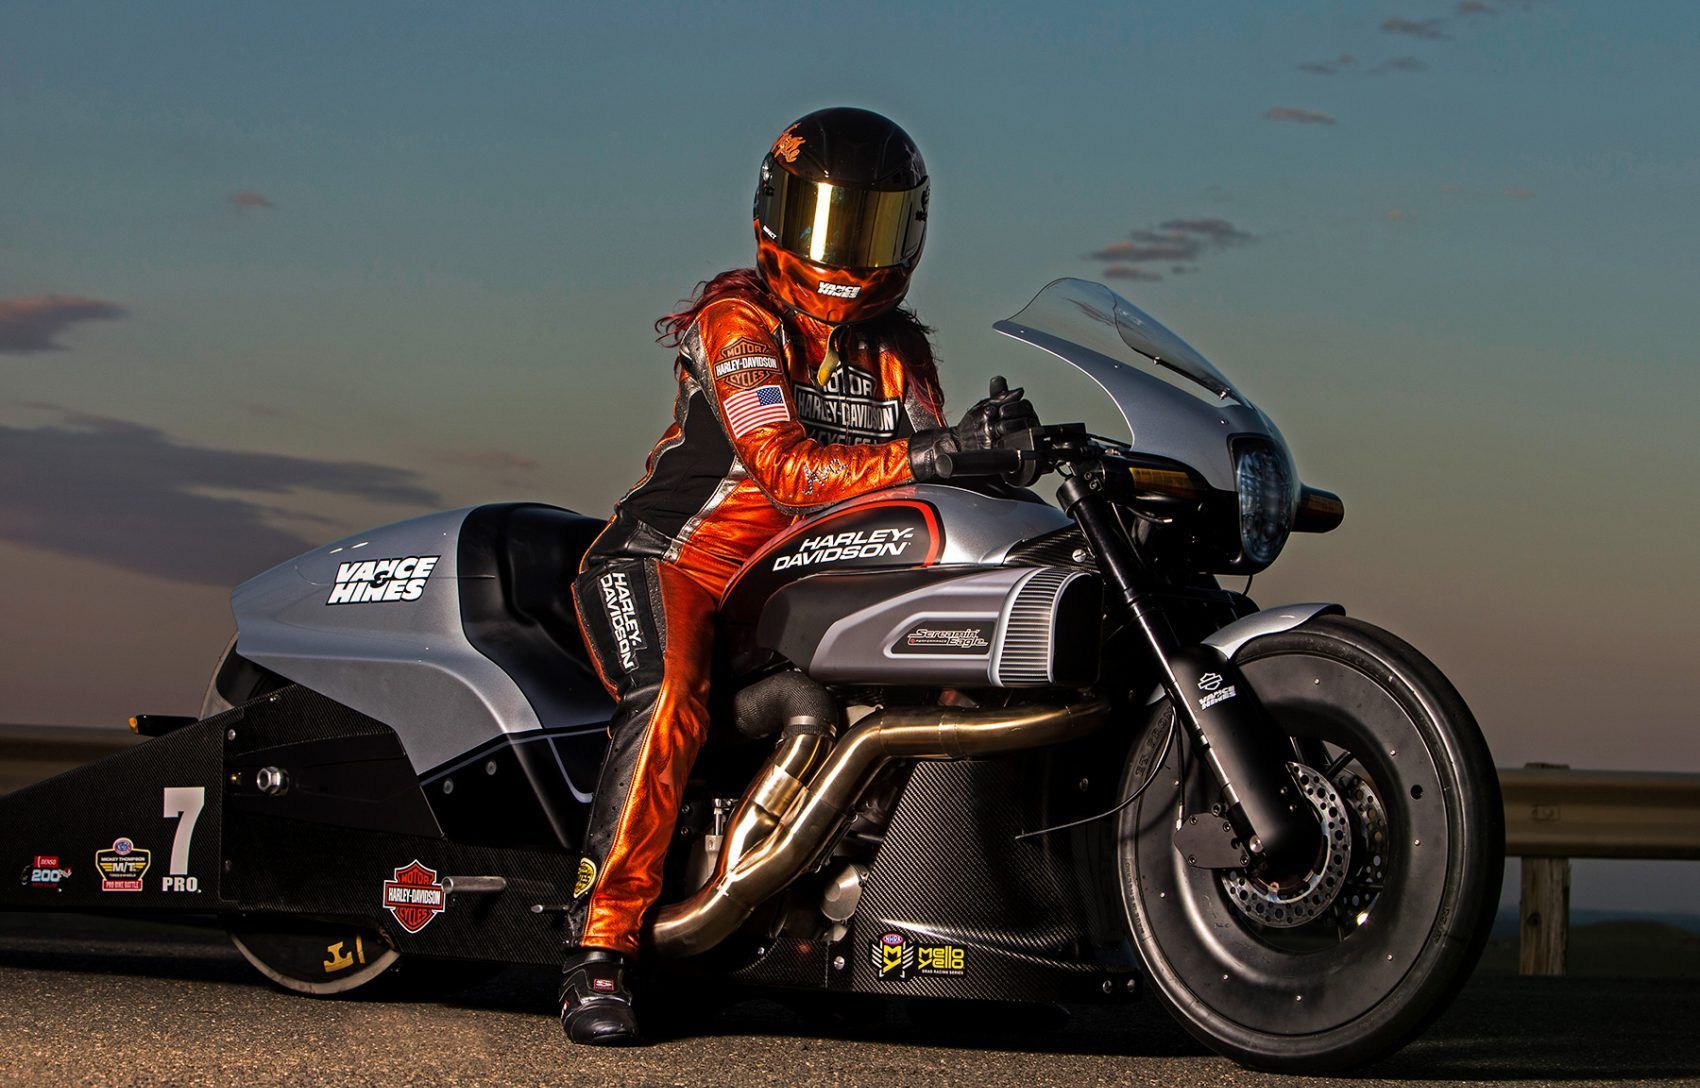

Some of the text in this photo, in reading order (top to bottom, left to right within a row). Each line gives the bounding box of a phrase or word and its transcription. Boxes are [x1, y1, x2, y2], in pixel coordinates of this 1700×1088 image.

[727, 342, 763, 357] MOTOR
[715, 356, 778, 377] HARLEY-DAVIDSON
[729, 370, 765, 387] CYCLES
[822, 367, 873, 396] OTOR
[798, 391, 895, 431] HARLEY-DAVIDSON
[799, 527, 915, 552] HARLEY-
[772, 541, 909, 572] DAVIDSON
[335, 556, 440, 583] VANCE
[327, 578, 427, 604] HINES
[600, 573, 635, 669] DAVIDSON
[947, 637, 989, 649] Eagle
[163, 786, 205, 875] 7
[31, 869, 61, 882] 200
[401, 868, 429, 885] MOTOR
[388, 887, 441, 905] HARLEY-DAVIDSON
[399, 907, 428, 925] CYCLES
